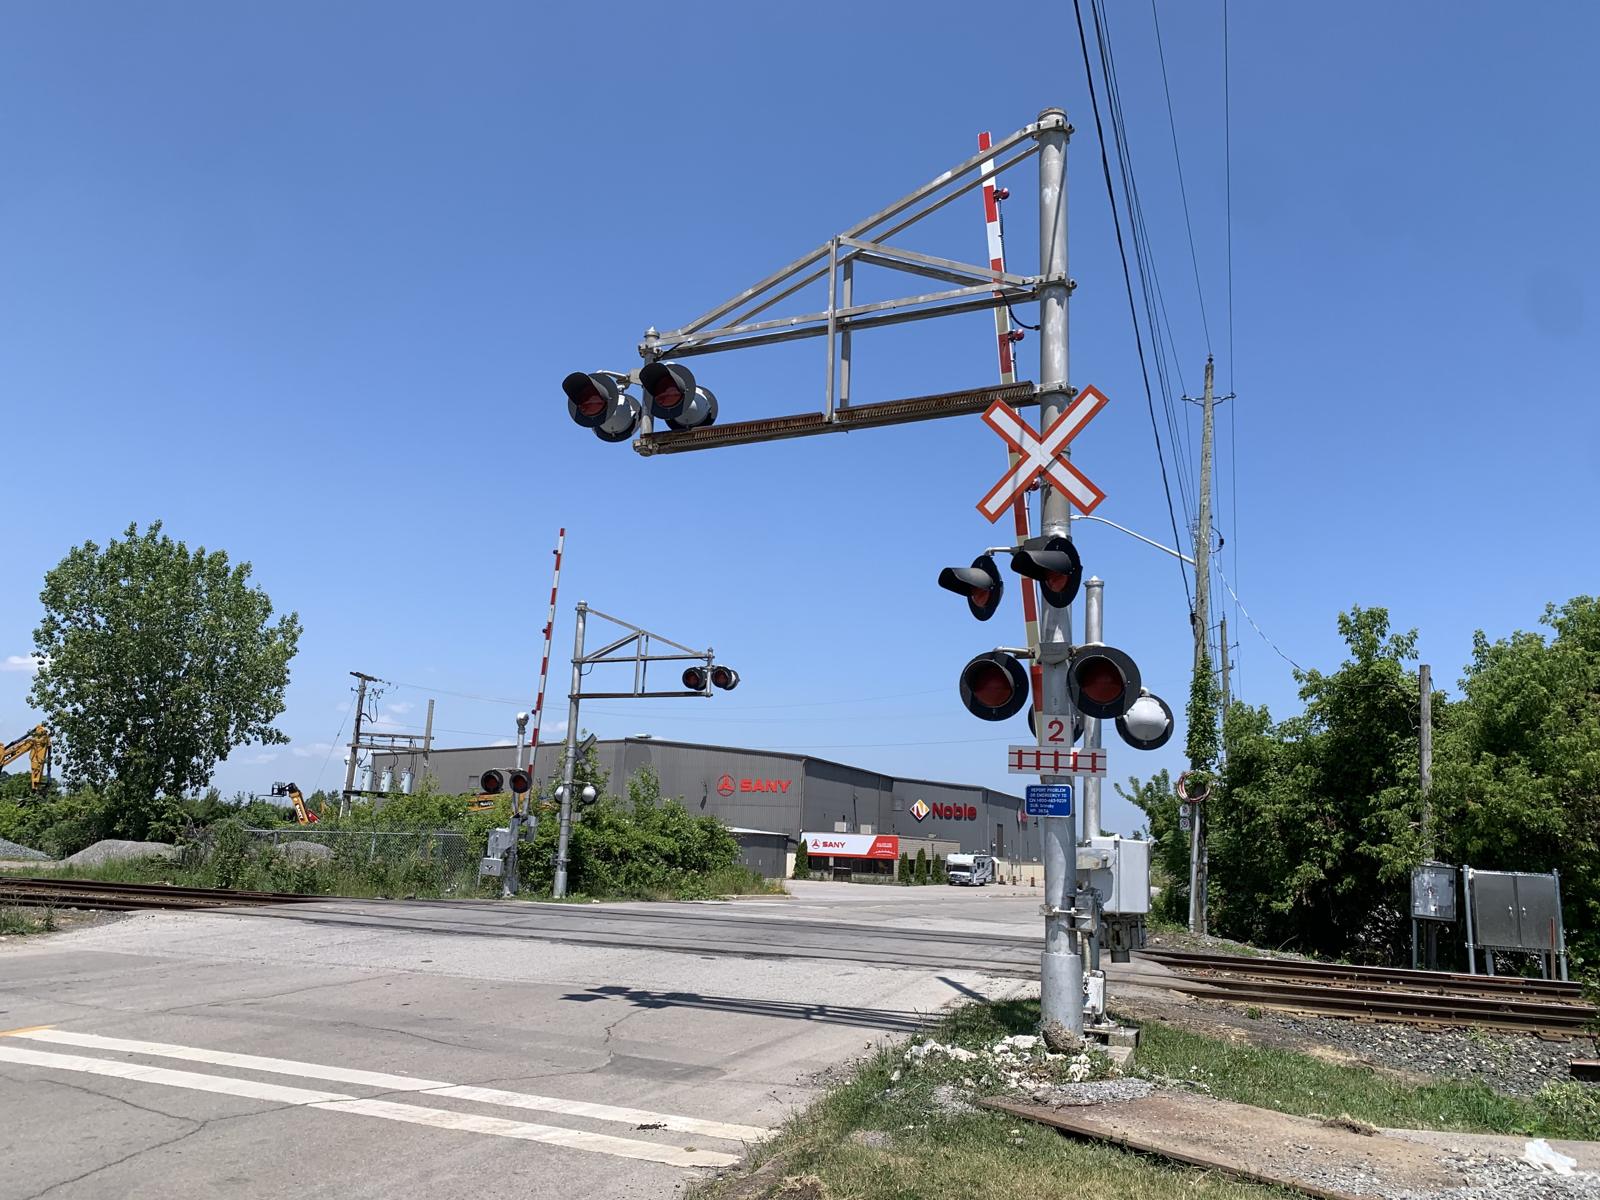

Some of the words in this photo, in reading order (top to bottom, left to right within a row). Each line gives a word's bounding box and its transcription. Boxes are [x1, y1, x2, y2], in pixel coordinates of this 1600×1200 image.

[1048, 720, 1065, 742] 2
[740, 778, 792, 794] SANY
[932, 802, 977, 819] Noble
[822, 841, 846, 849] SANY
